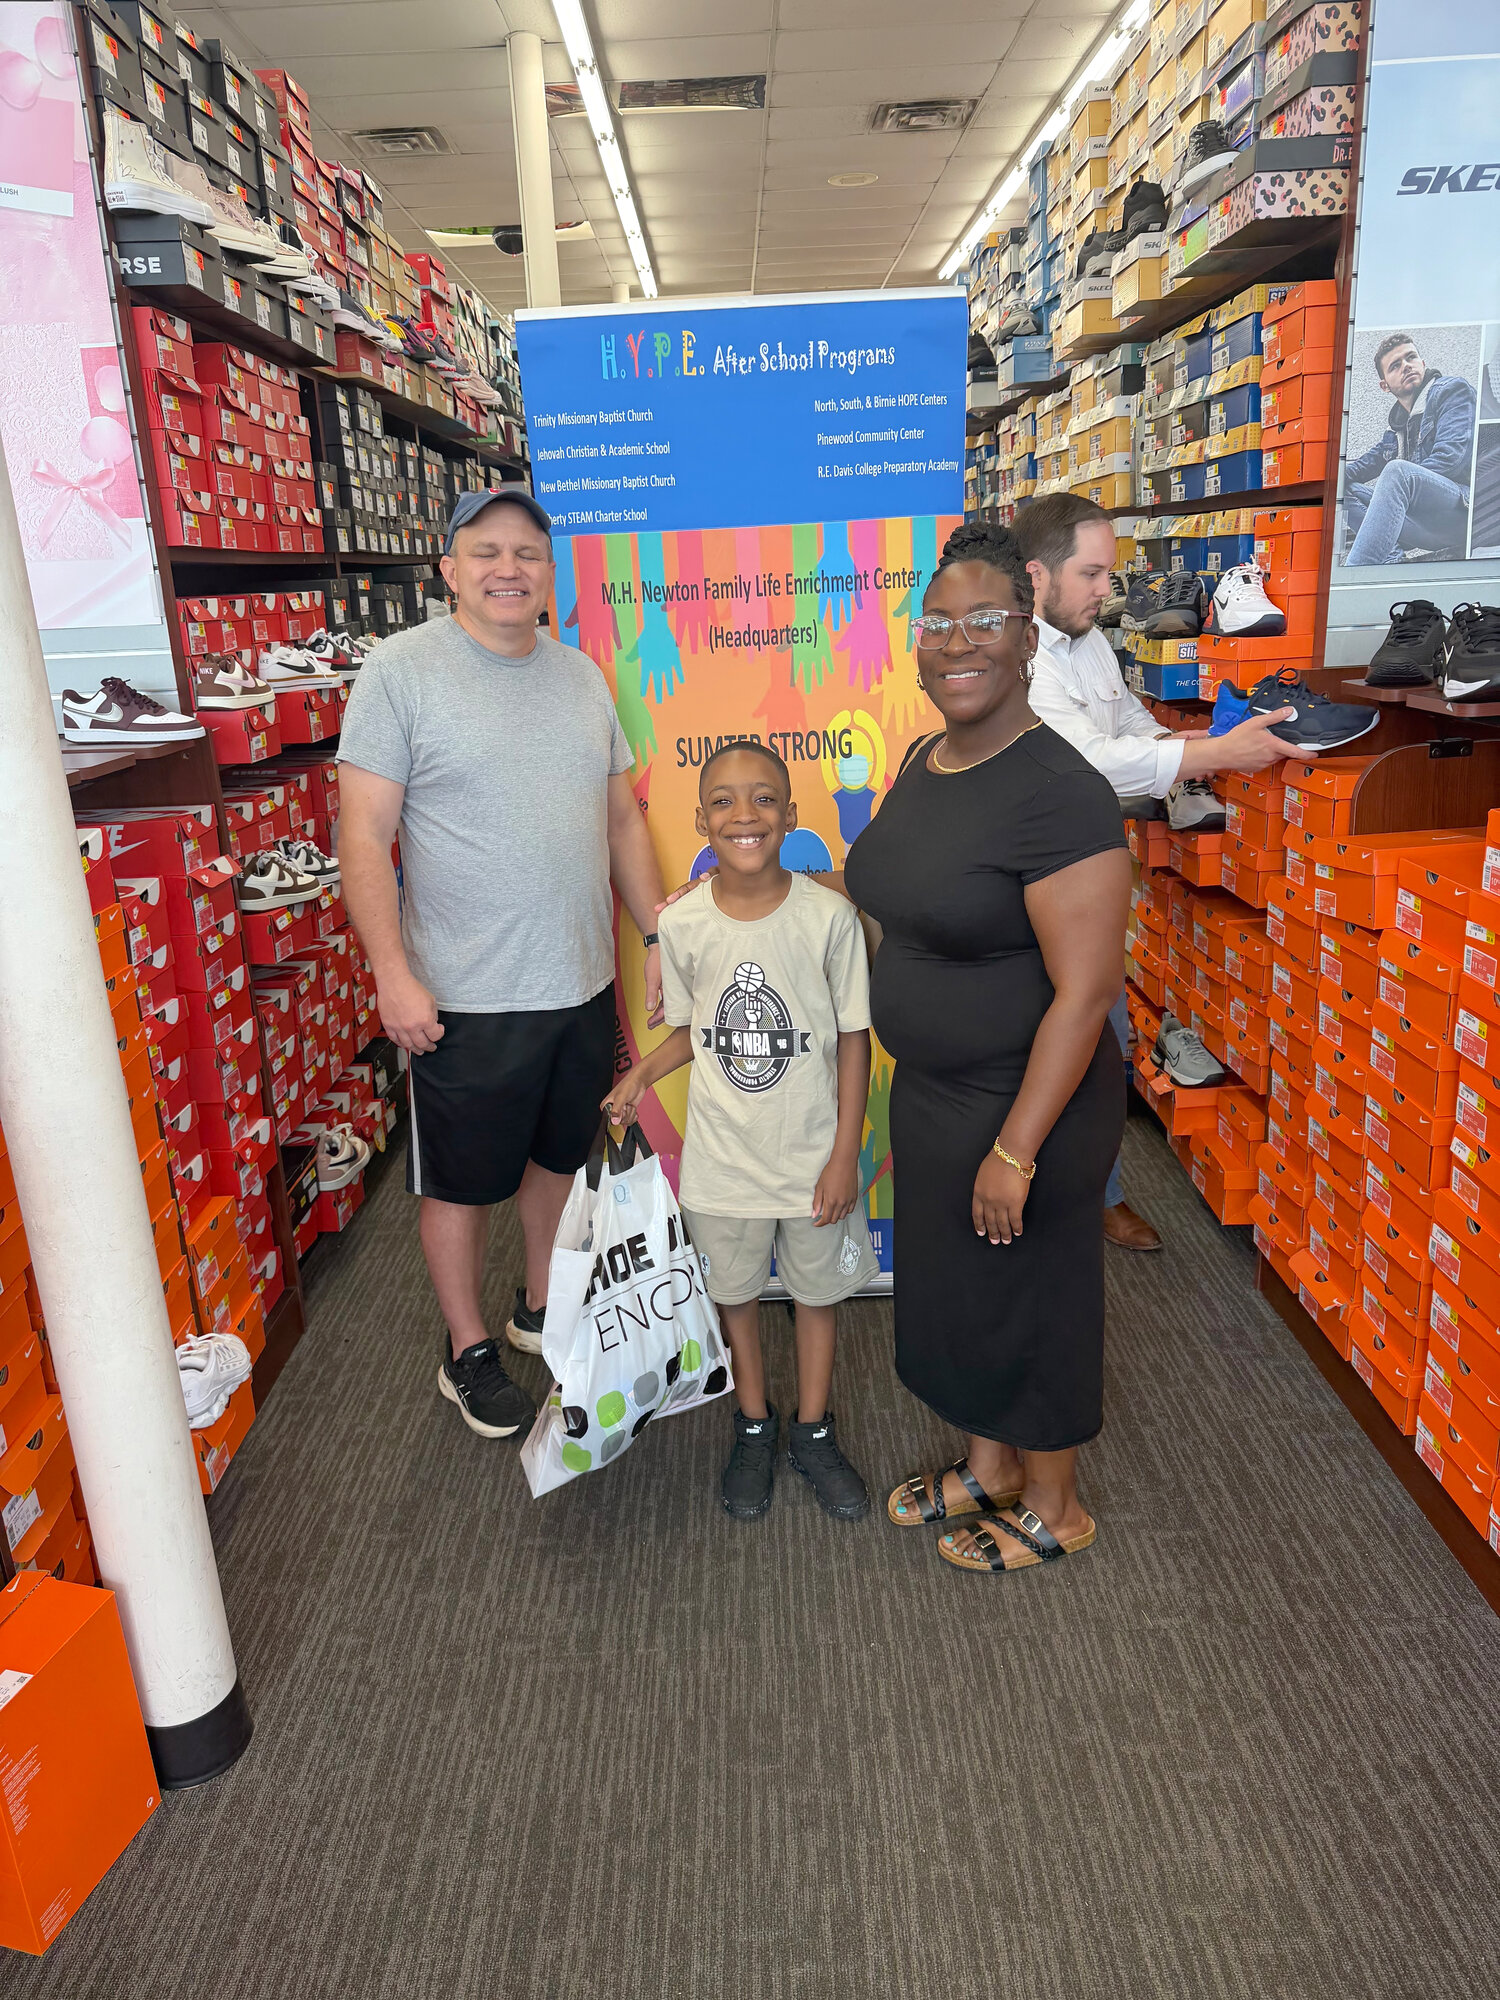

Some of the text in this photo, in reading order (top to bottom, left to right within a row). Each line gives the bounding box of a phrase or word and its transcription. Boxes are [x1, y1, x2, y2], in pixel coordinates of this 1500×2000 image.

[1396, 163, 1500, 195] SKE
[713, 345, 756, 376] After
[760, 340, 814, 371] School
[818, 340, 895, 375] Programs
[814, 393, 948, 413] North, South, & Birnie HOPE Centers
[533, 408, 653, 428] Trinity Missionary Baptist Church
[817, 427, 925, 445] Pinewood Community Center
[537, 441, 670, 461] Jehovah Christian & Academic School
[818, 458, 959, 478] R.E. Davis College Preparatory Academy
[540, 474, 676, 493] New Bethel Missionary Baptist Church
[568, 511, 593, 525] STEAM
[594, 510, 622, 523] Charter
[623, 508, 648, 521] School
[601, 567, 923, 605] M.H. Newton Family Life Enrichment Center
[708, 618, 819, 654] (Headquarters)
[199, 667, 214, 675] NIKE
[769, 729, 853, 762] STRONG
[743, 1032, 771, 1056] NBA
[583, 1232, 655, 1306] HOE
